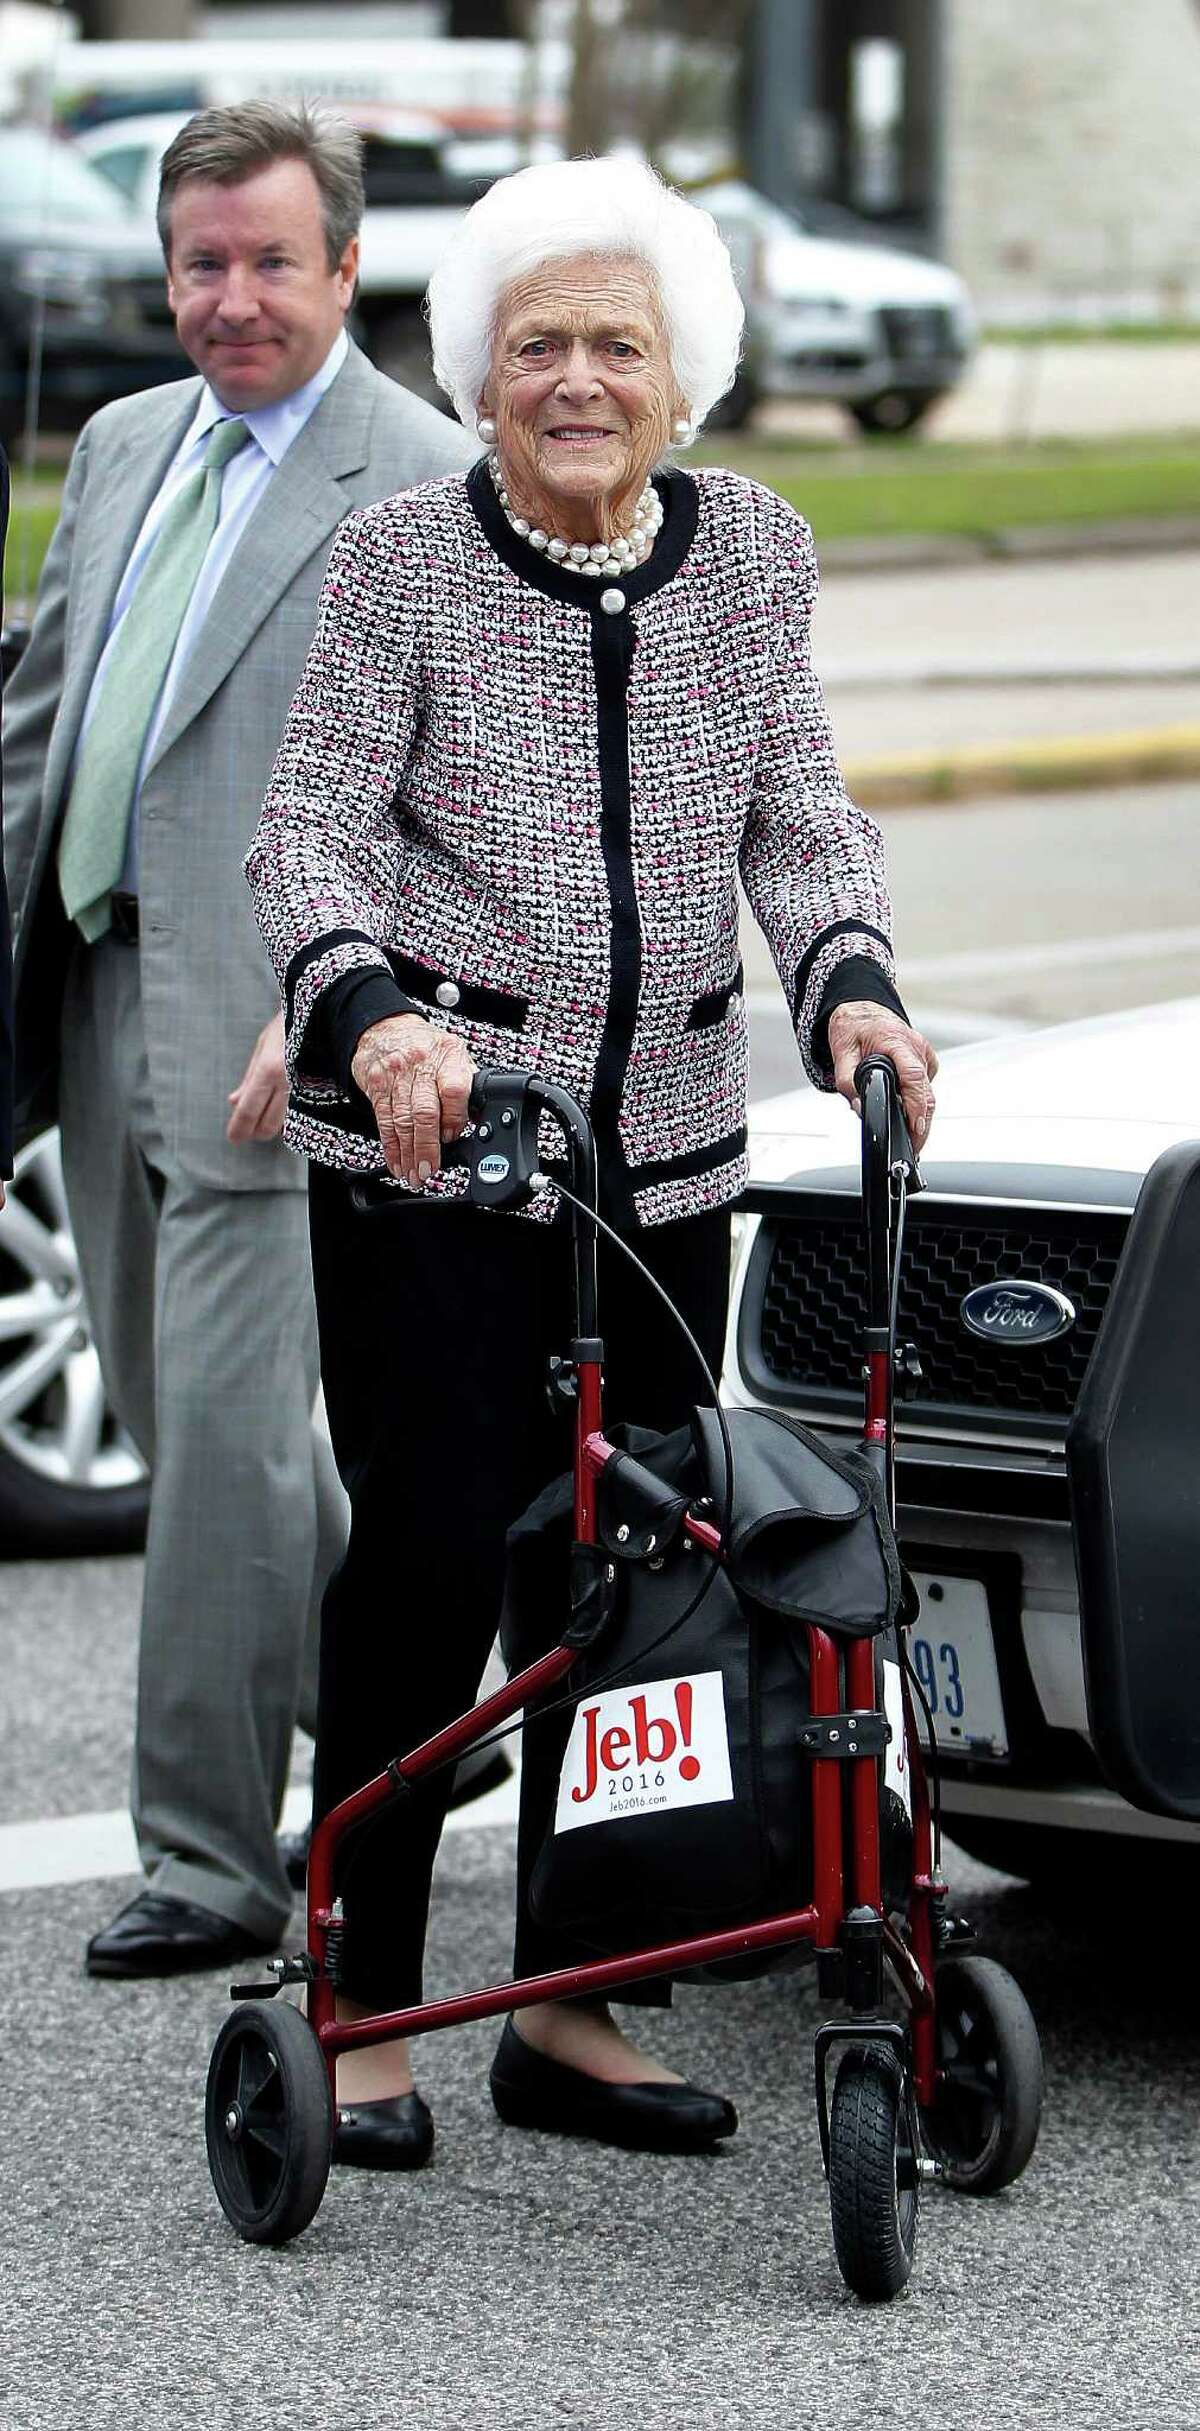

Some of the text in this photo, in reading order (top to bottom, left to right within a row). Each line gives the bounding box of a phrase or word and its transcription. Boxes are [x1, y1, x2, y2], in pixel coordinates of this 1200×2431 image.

[480, 1162, 507, 1173] LUMEX
[984, 1290, 1044, 1328] Ford
[913, 1639, 965, 1719] 93
[571, 1681, 701, 1803] Jeb!
[608, 1770, 666, 1796] 2016
[609, 1794, 668, 1813] Jeb2016.com
